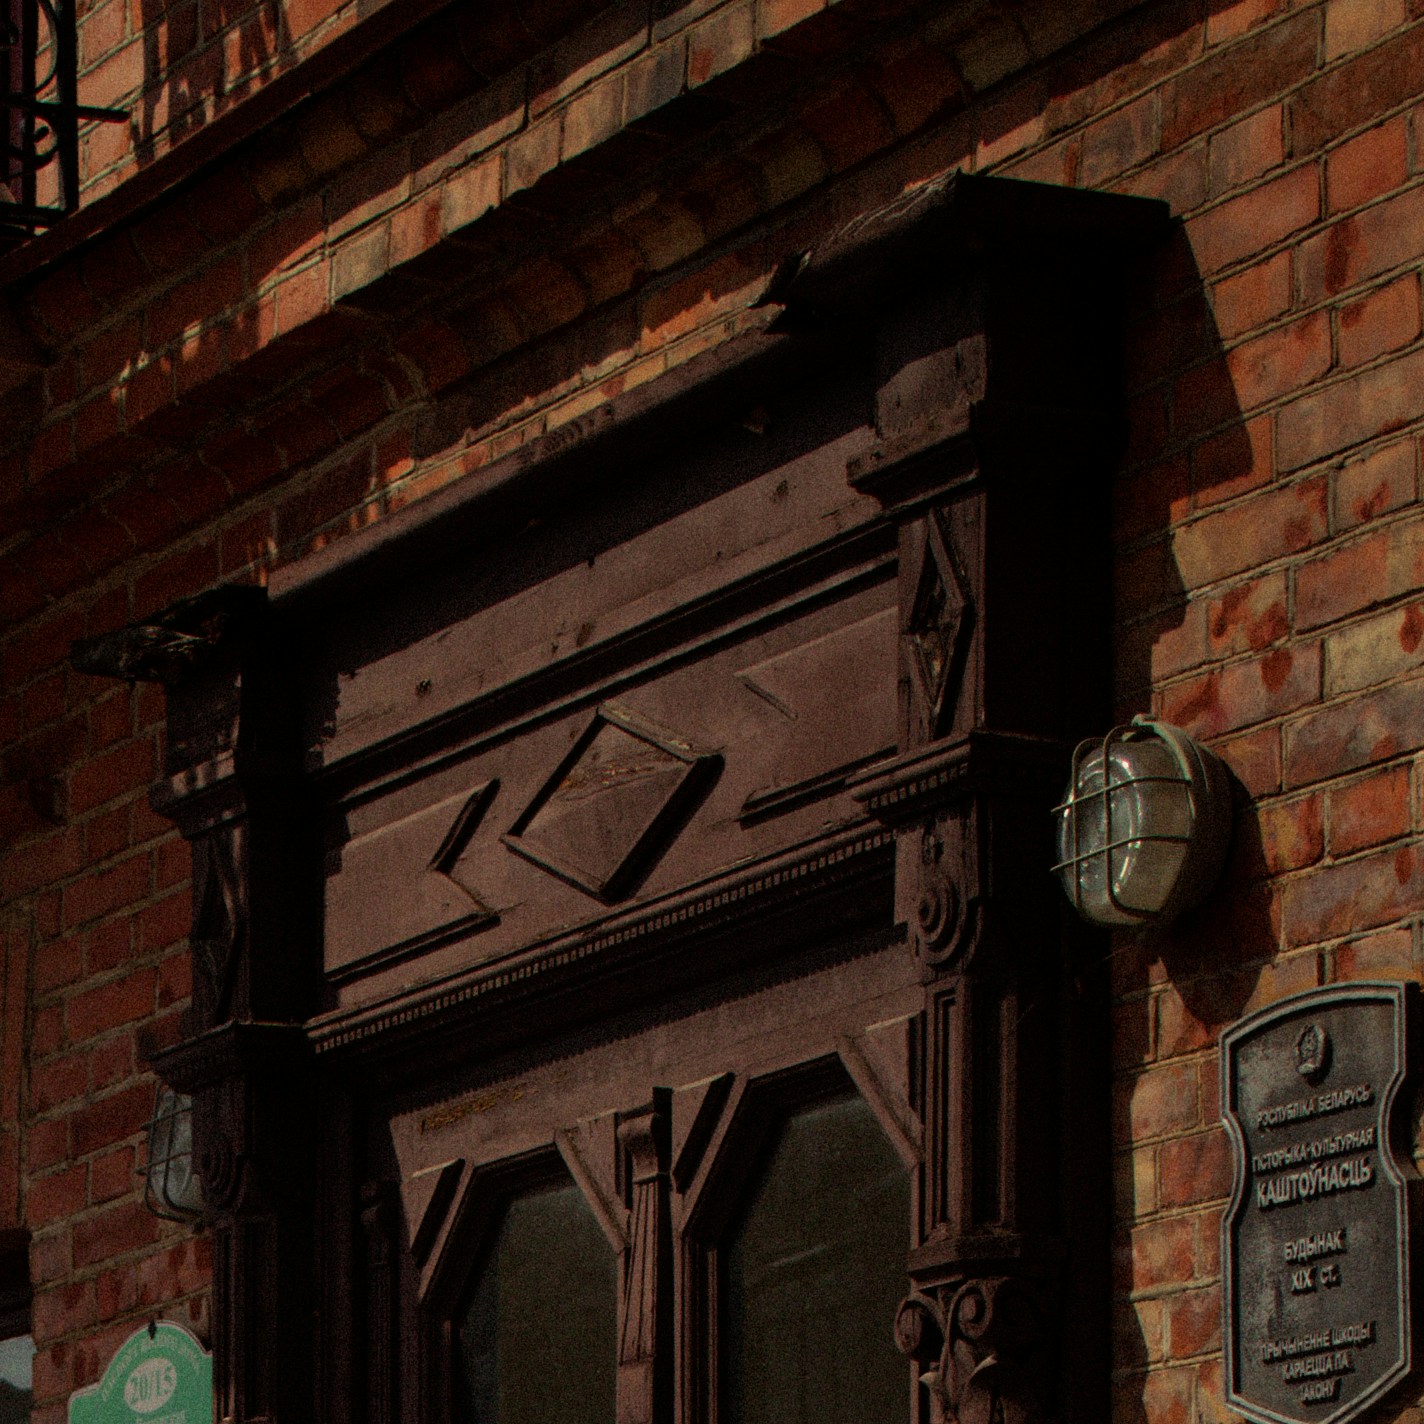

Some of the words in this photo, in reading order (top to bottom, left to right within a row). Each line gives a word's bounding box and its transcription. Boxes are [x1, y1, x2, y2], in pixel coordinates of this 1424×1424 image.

[1318, 1085, 1372, 1113] БЕЛАРУСЬ
[1257, 1157, 1372, 1208] КАШТОЎНАСЦЬ
[1283, 1230, 1344, 1262] БУДЫНАК
